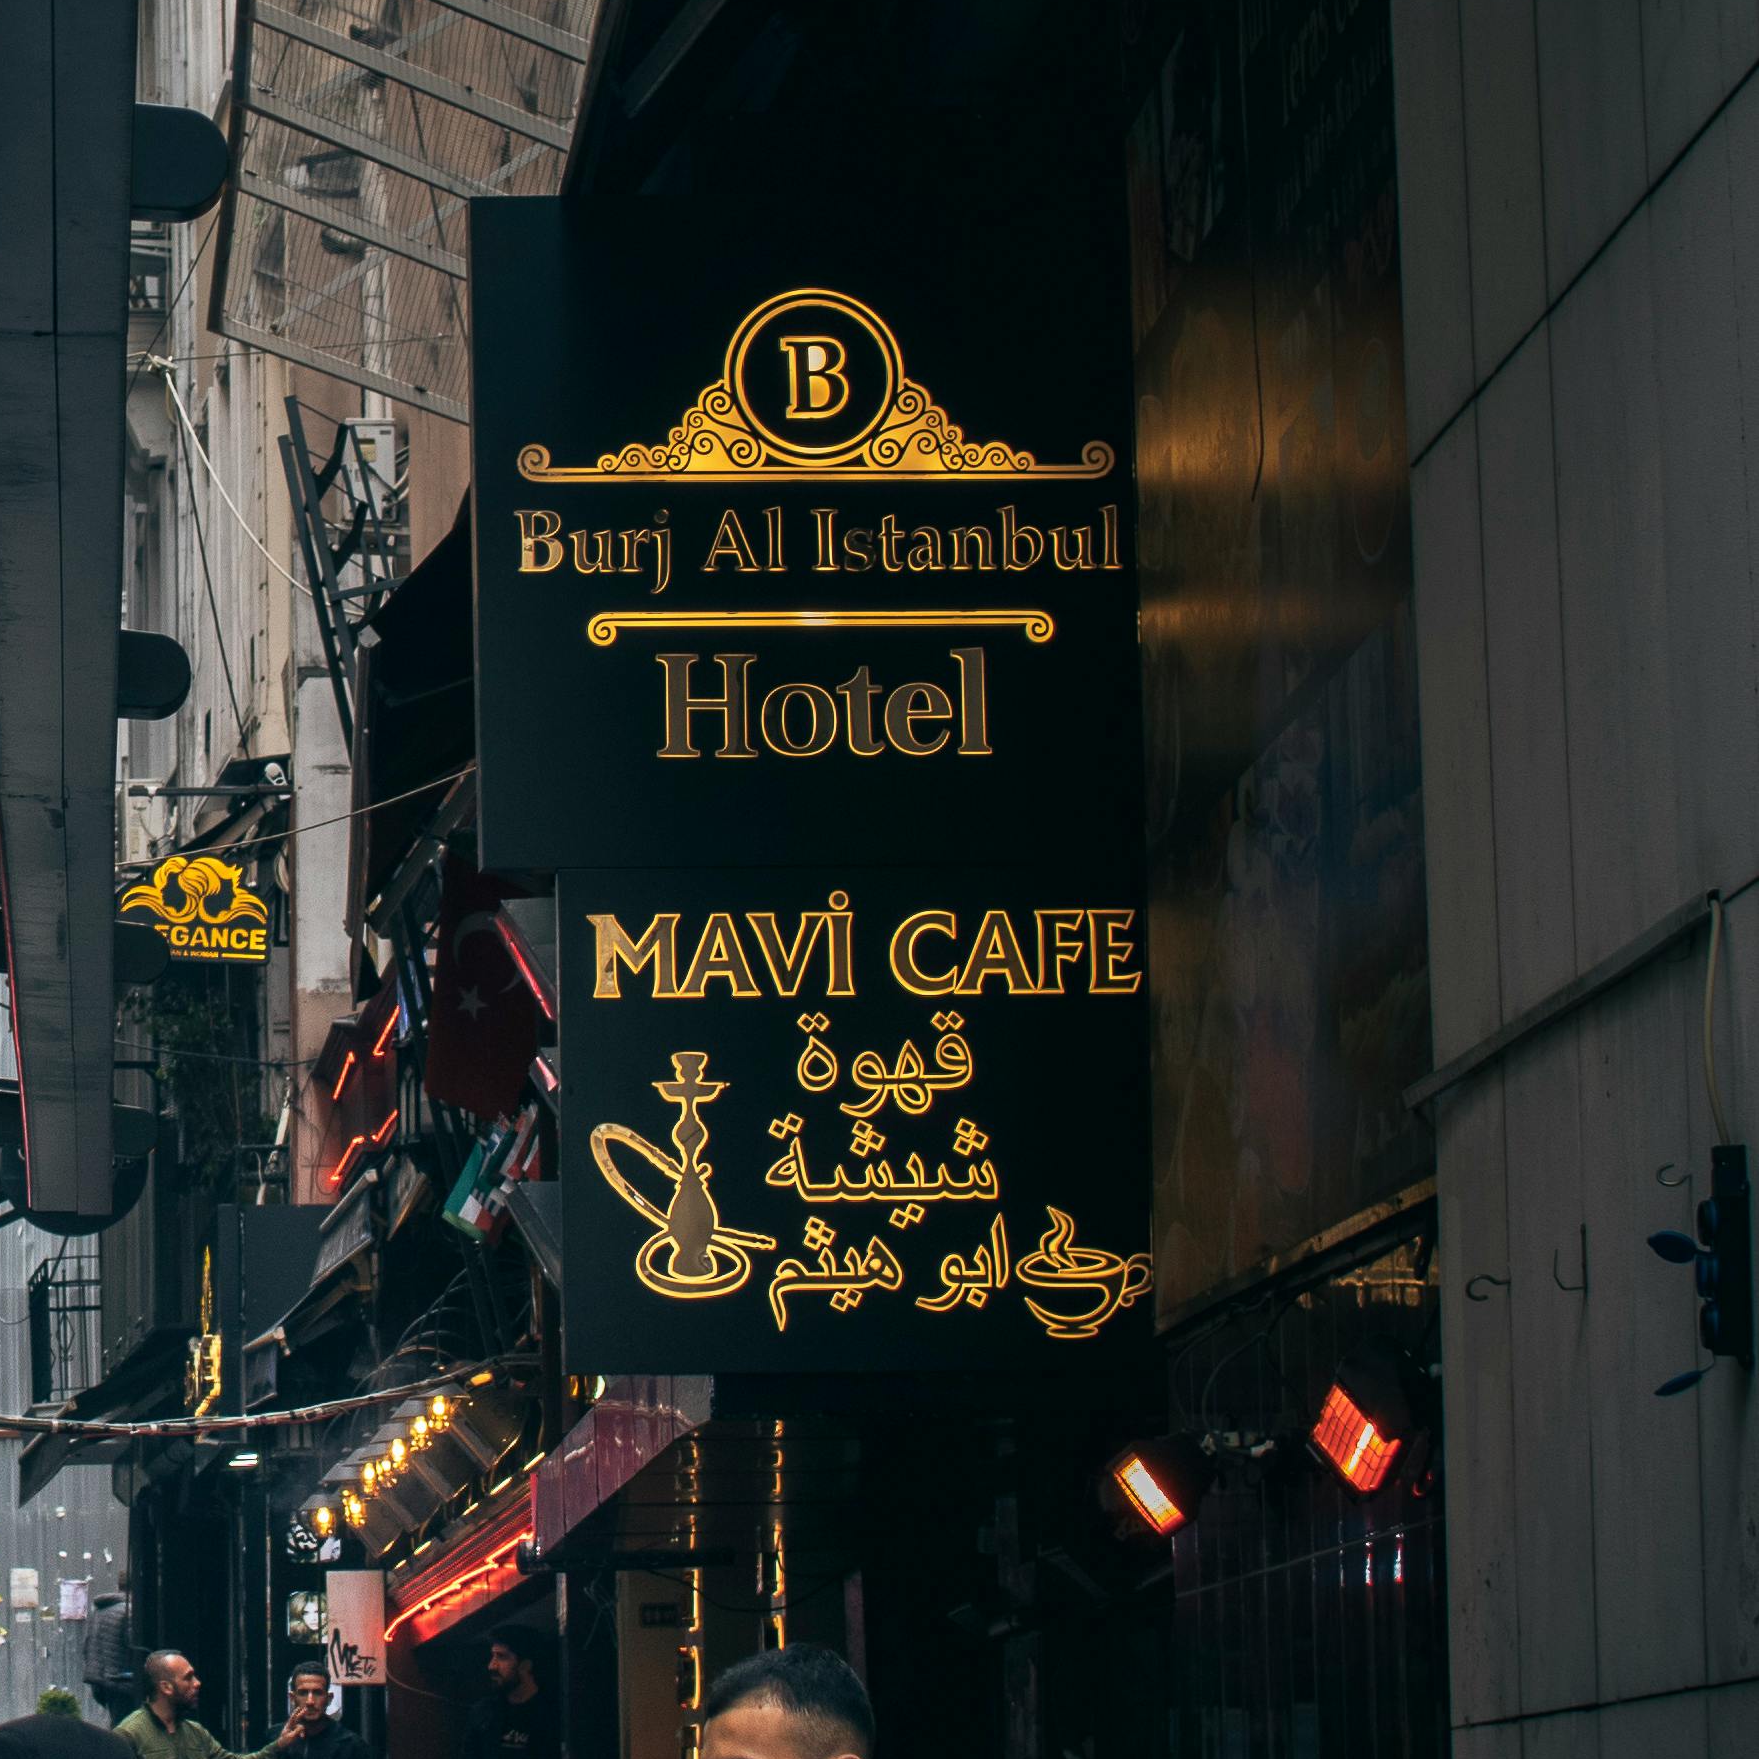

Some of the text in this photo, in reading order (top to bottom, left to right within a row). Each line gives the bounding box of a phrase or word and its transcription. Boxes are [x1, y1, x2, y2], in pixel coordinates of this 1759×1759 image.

[778, 335, 850, 420] B
[513, 503, 1125, 595] Burj Al Istanbul
[654, 646, 995, 761] Hotel
[585, 889, 1145, 1000] MAVİ CAFE
[796, 1009, 975, 1118] قهوة
[764, 1112, 1001, 1231] شيشة
